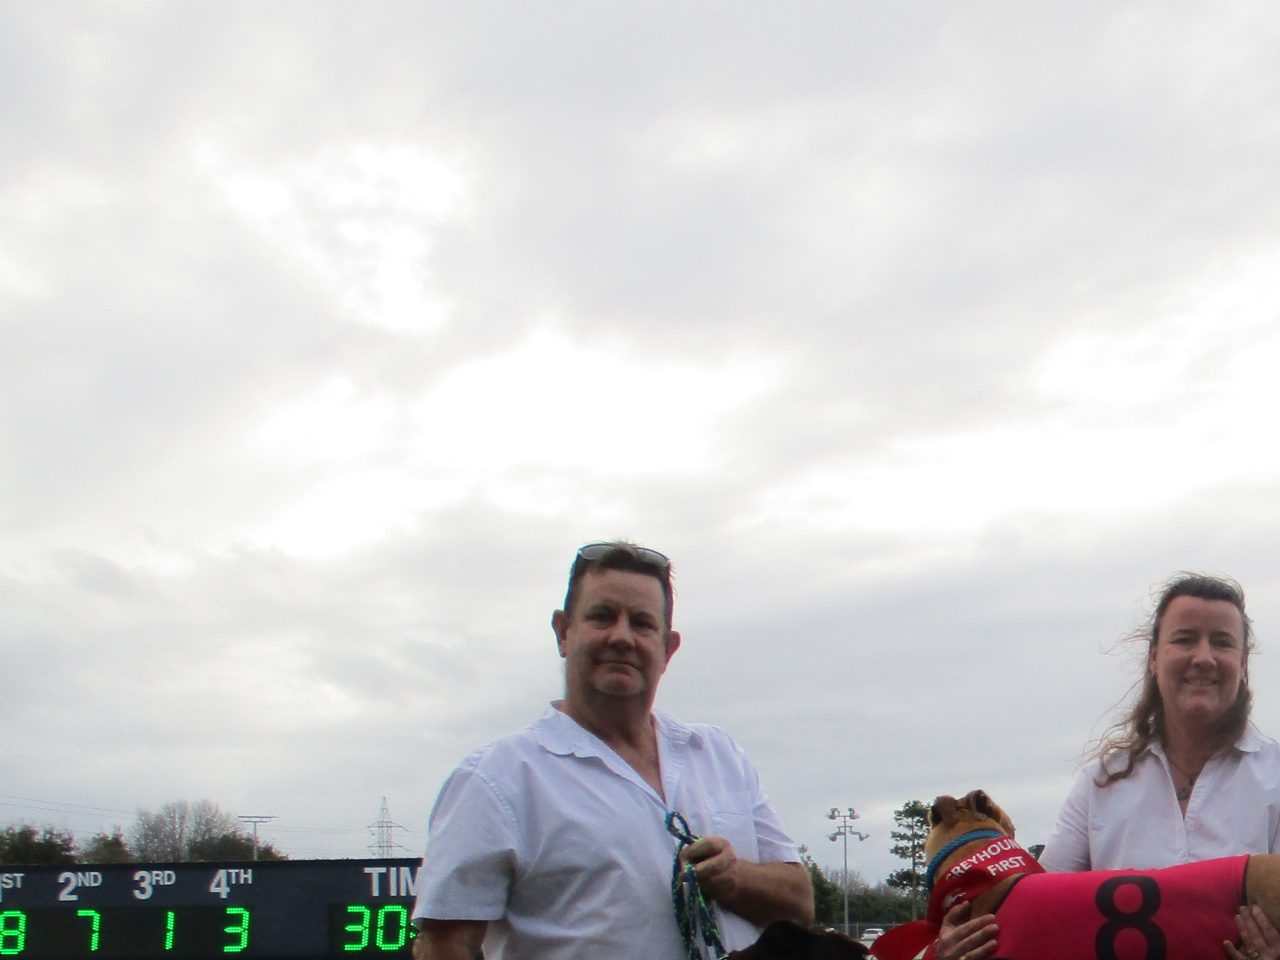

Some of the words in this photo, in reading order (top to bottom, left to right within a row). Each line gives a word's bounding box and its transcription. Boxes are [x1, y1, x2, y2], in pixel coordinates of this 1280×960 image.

[987, 855, 1026, 876] FIRST
[58, 871, 103, 901] 2ND
[133, 870, 177, 900] 3RD
[209, 868, 253, 899] 4TH
[77, 909, 100, 951] 7
[165, 911, 175, 950] 1
[223, 907, 250, 952] 3
